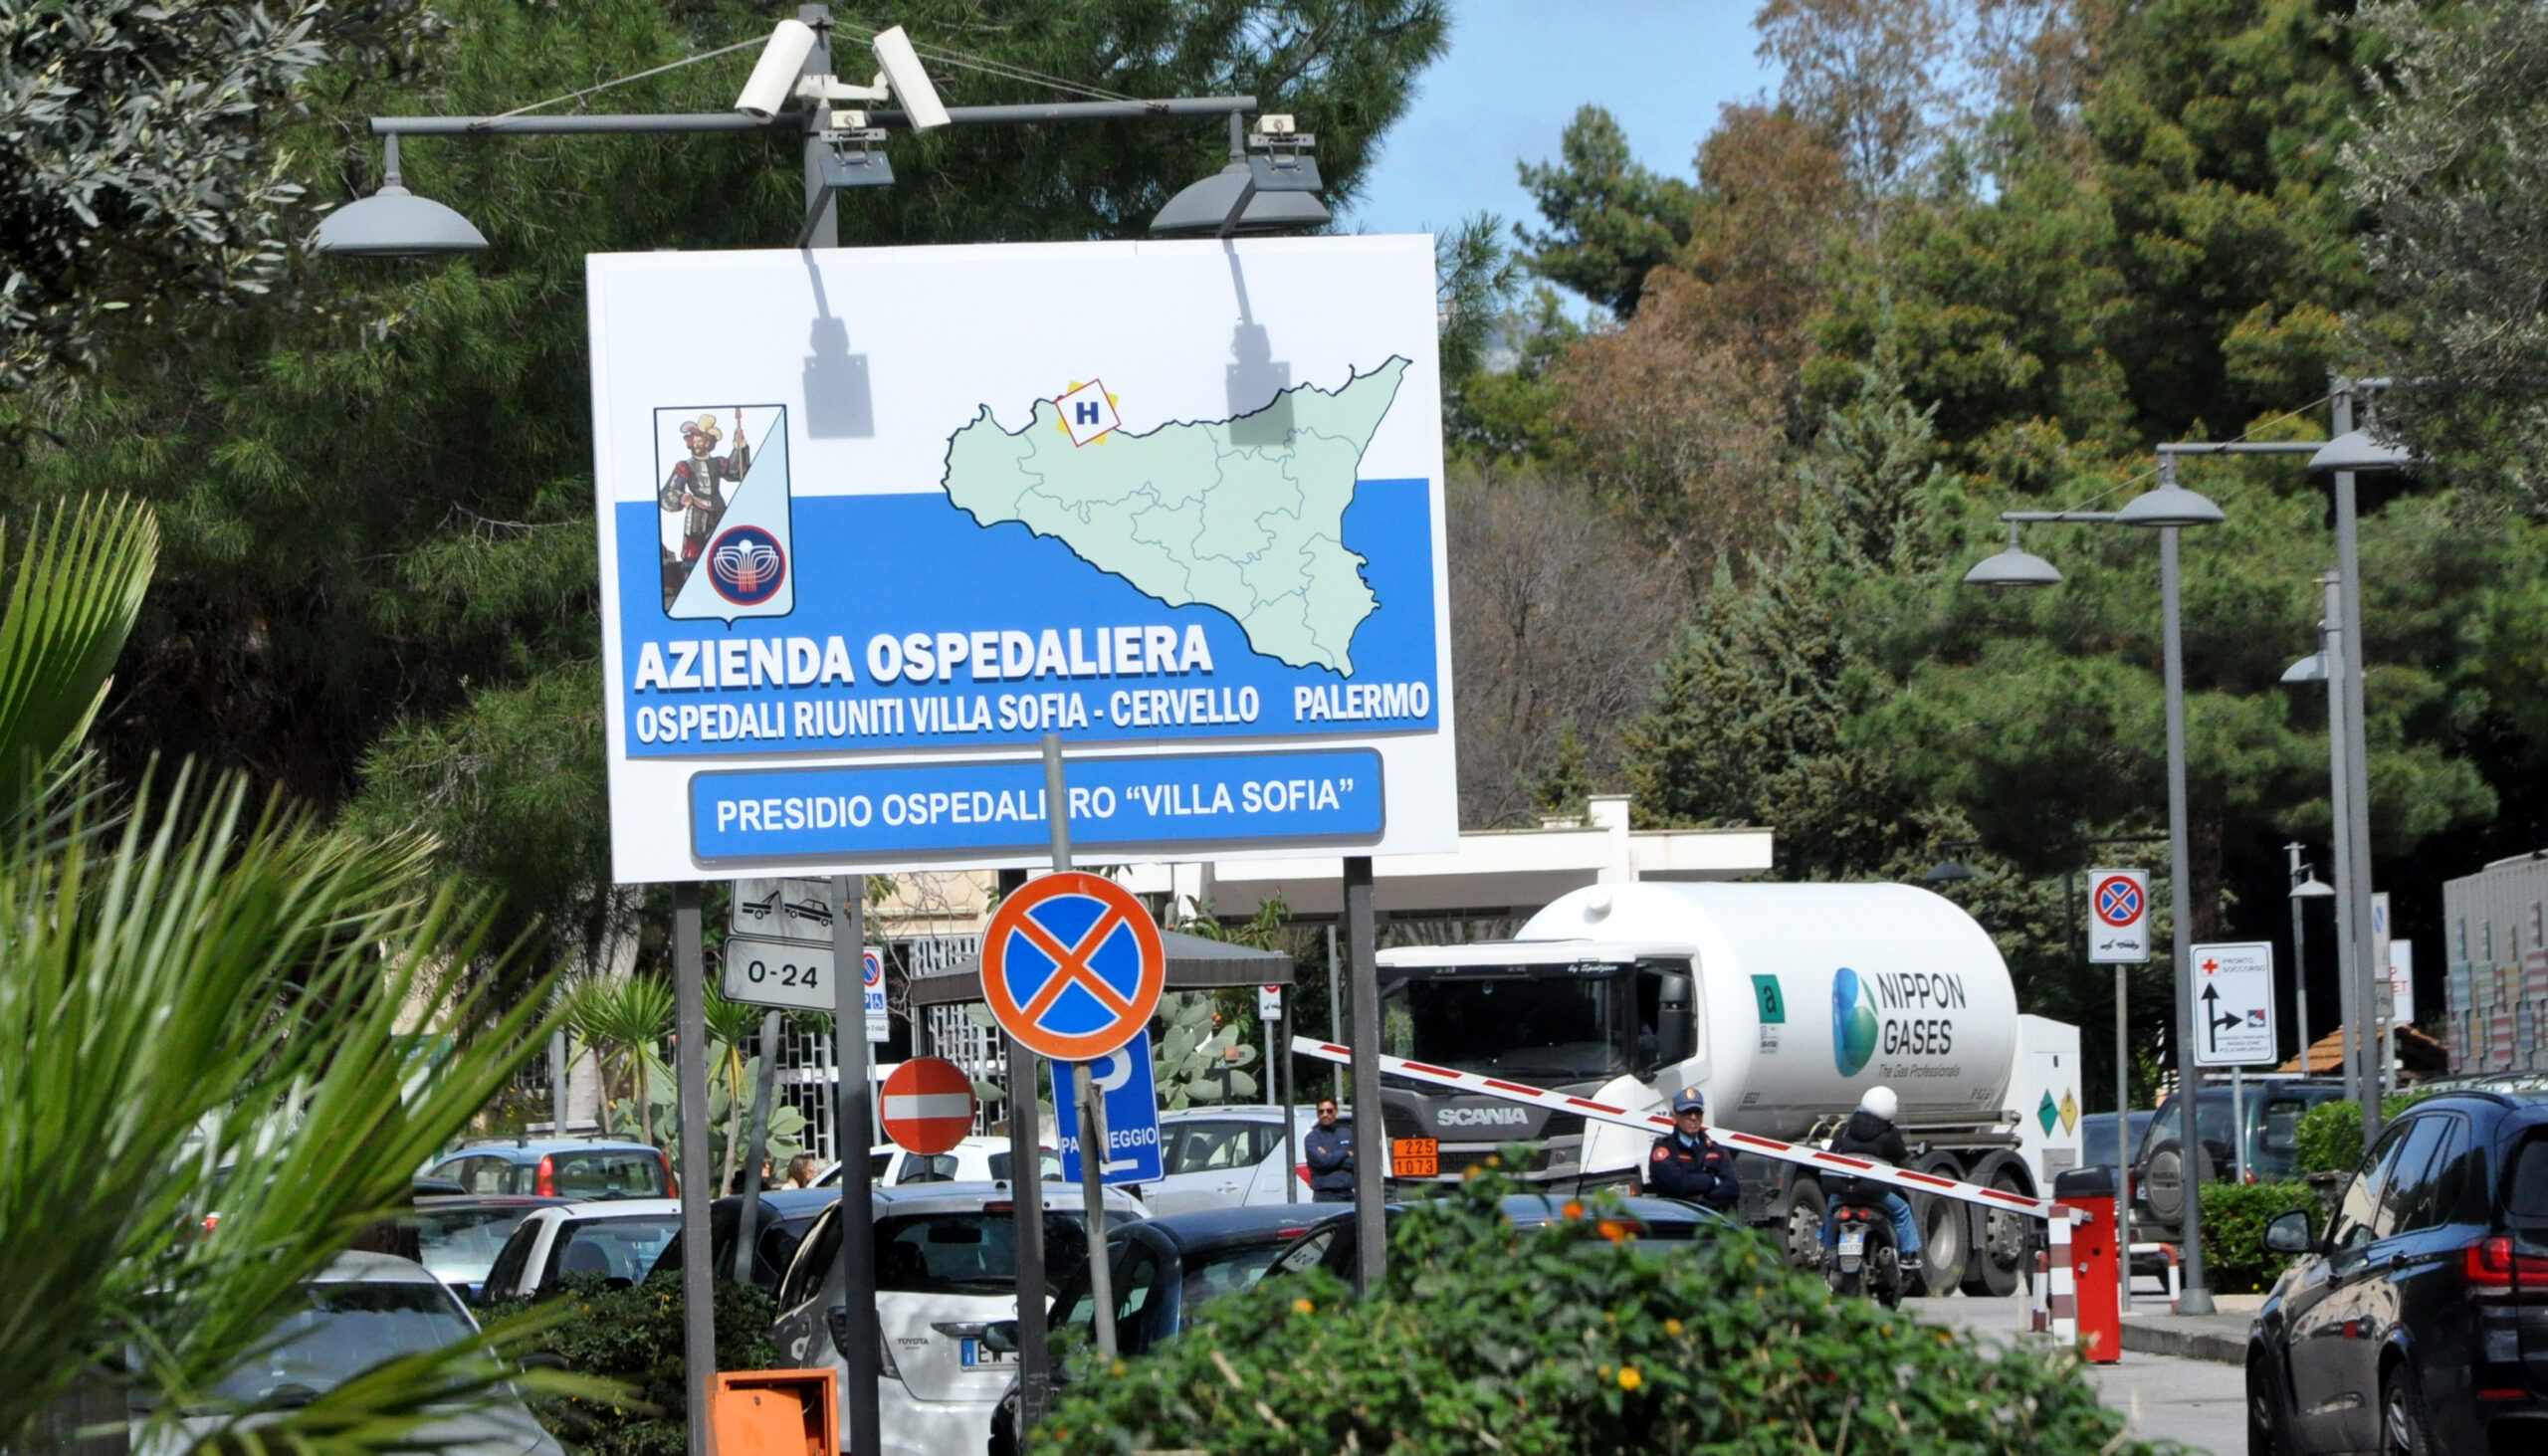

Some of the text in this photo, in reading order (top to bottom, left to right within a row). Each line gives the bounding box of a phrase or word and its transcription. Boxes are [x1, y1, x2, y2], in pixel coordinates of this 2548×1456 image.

[1076, 401, 1099, 425] H
[634, 624, 1214, 691] AZIENDA OSPEDALIERA
[636, 702, 785, 743] OSPEDALI
[795, 699, 904, 738] RIUNITI
[910, 696, 992, 733] VILLA
[998, 693, 1089, 730] SOFIA
[1110, 686, 1259, 728] CERVELLO
[1295, 682, 1429, 722] PALERMO
[717, 795, 872, 832] PRESIDIO
[882, 786, 1116, 827] OSPEDALIRO
[1876, 972, 1966, 1009] NIPPON
[1883, 1019, 1953, 1055] GASES
[1437, 1108, 1529, 1127] SCANIA
[1061, 1127, 1157, 1155] PAEGGIO
[1405, 1142, 1433, 1154] 225
[1396, 1159, 1433, 1173] 1073
